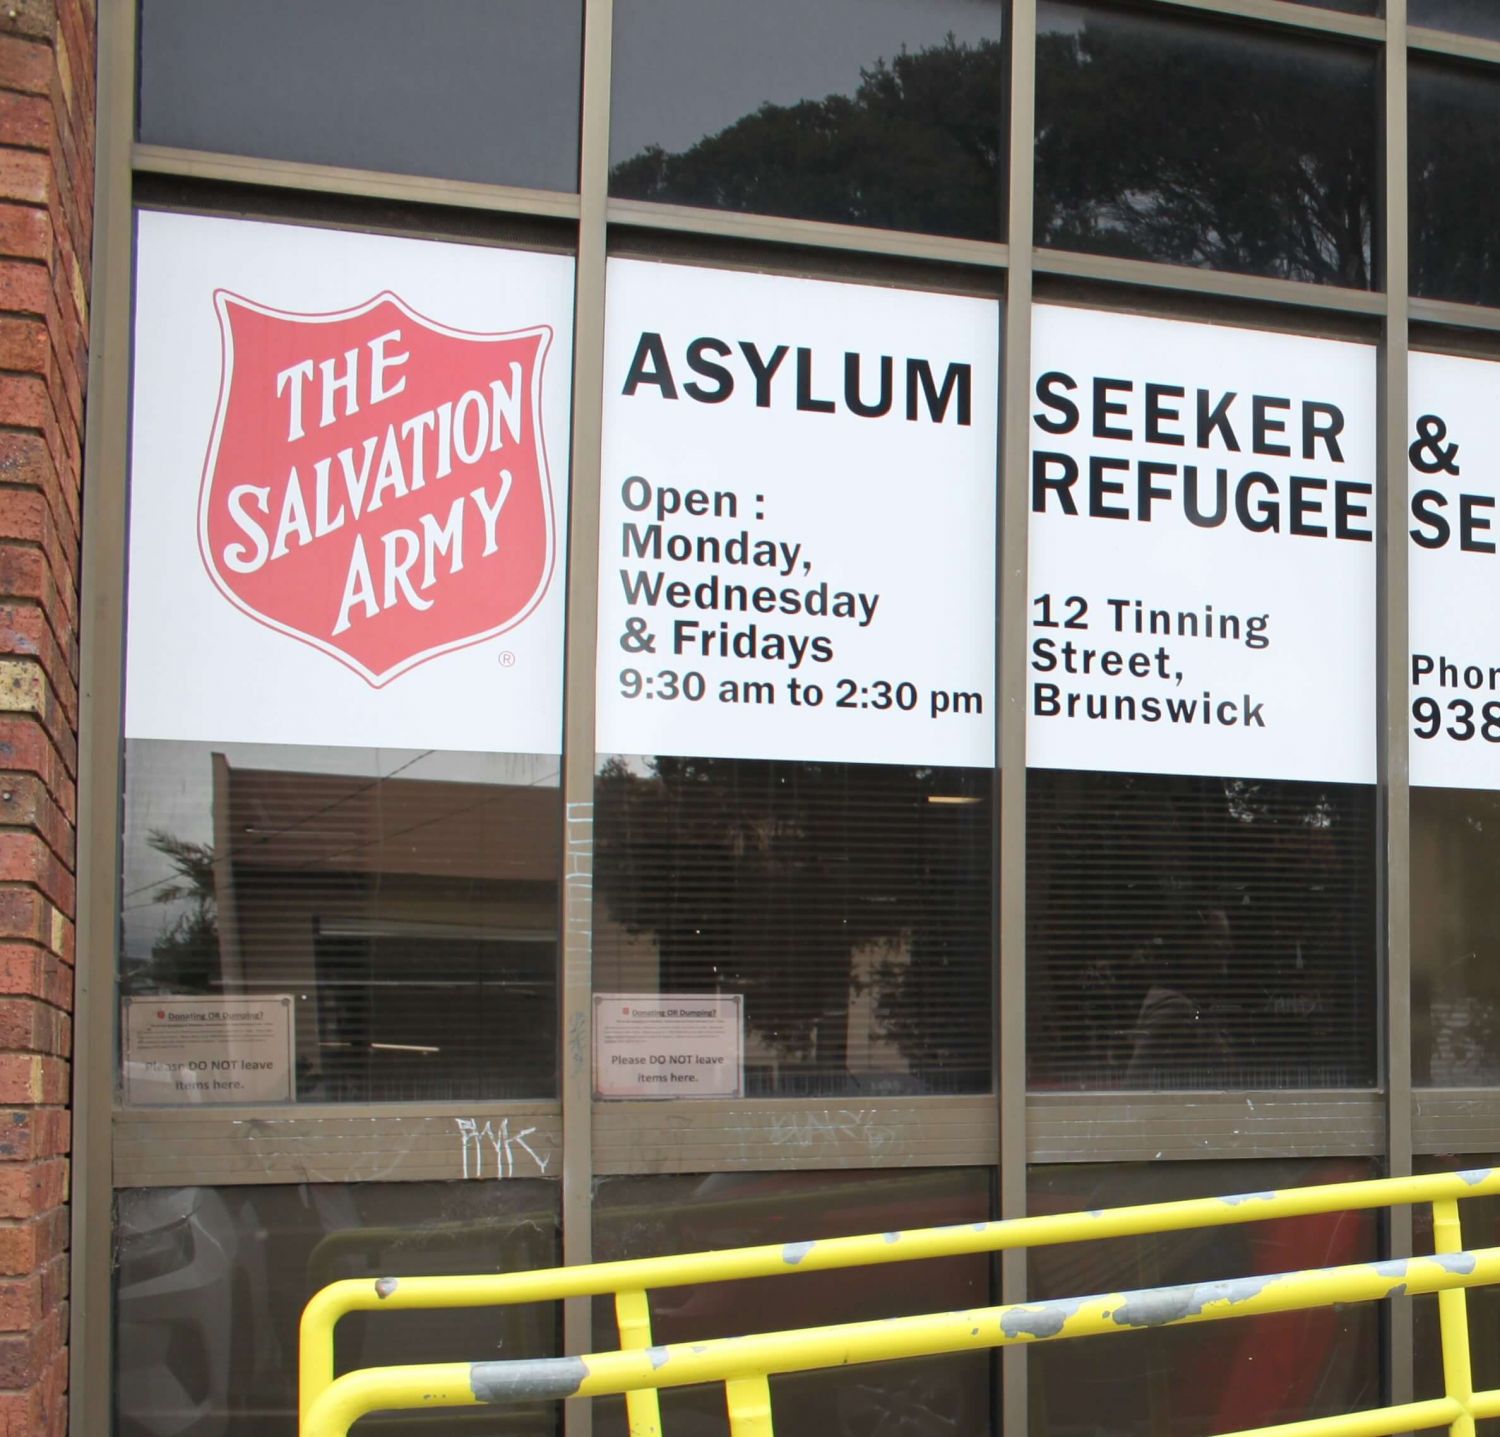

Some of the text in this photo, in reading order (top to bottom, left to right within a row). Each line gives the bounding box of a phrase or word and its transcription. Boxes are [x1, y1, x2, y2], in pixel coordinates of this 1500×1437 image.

[276, 329, 410, 443] THE
[622, 332, 1459, 475] ASYLUM SEEKER &
[223, 361, 524, 575] SALVATION
[622, 477, 736, 521] Open
[1033, 451, 1372, 542] REFUGEE
[331, 469, 514, 637] ARMY
[623, 524, 810, 576] Monday,
[621, 571, 878, 629] Wednesday
[1034, 594, 1269, 648] 12 Tinning
[621, 618, 832, 669] & Fridays
[1032, 638, 1182, 684] Street,
[622, 671, 982, 718] 9:30 am to 2:30 pm
[1035, 683, 1264, 726] Brunswick
[175, 1079, 245, 1090] items here.
[188, 1060, 207, 1071] DO
[211, 1060, 237, 1071] NOT
[241, 1060, 273, 1071] leave
[611, 1055, 724, 1065] Please DO NOT leave
[638, 1072, 698, 1083] items here.
